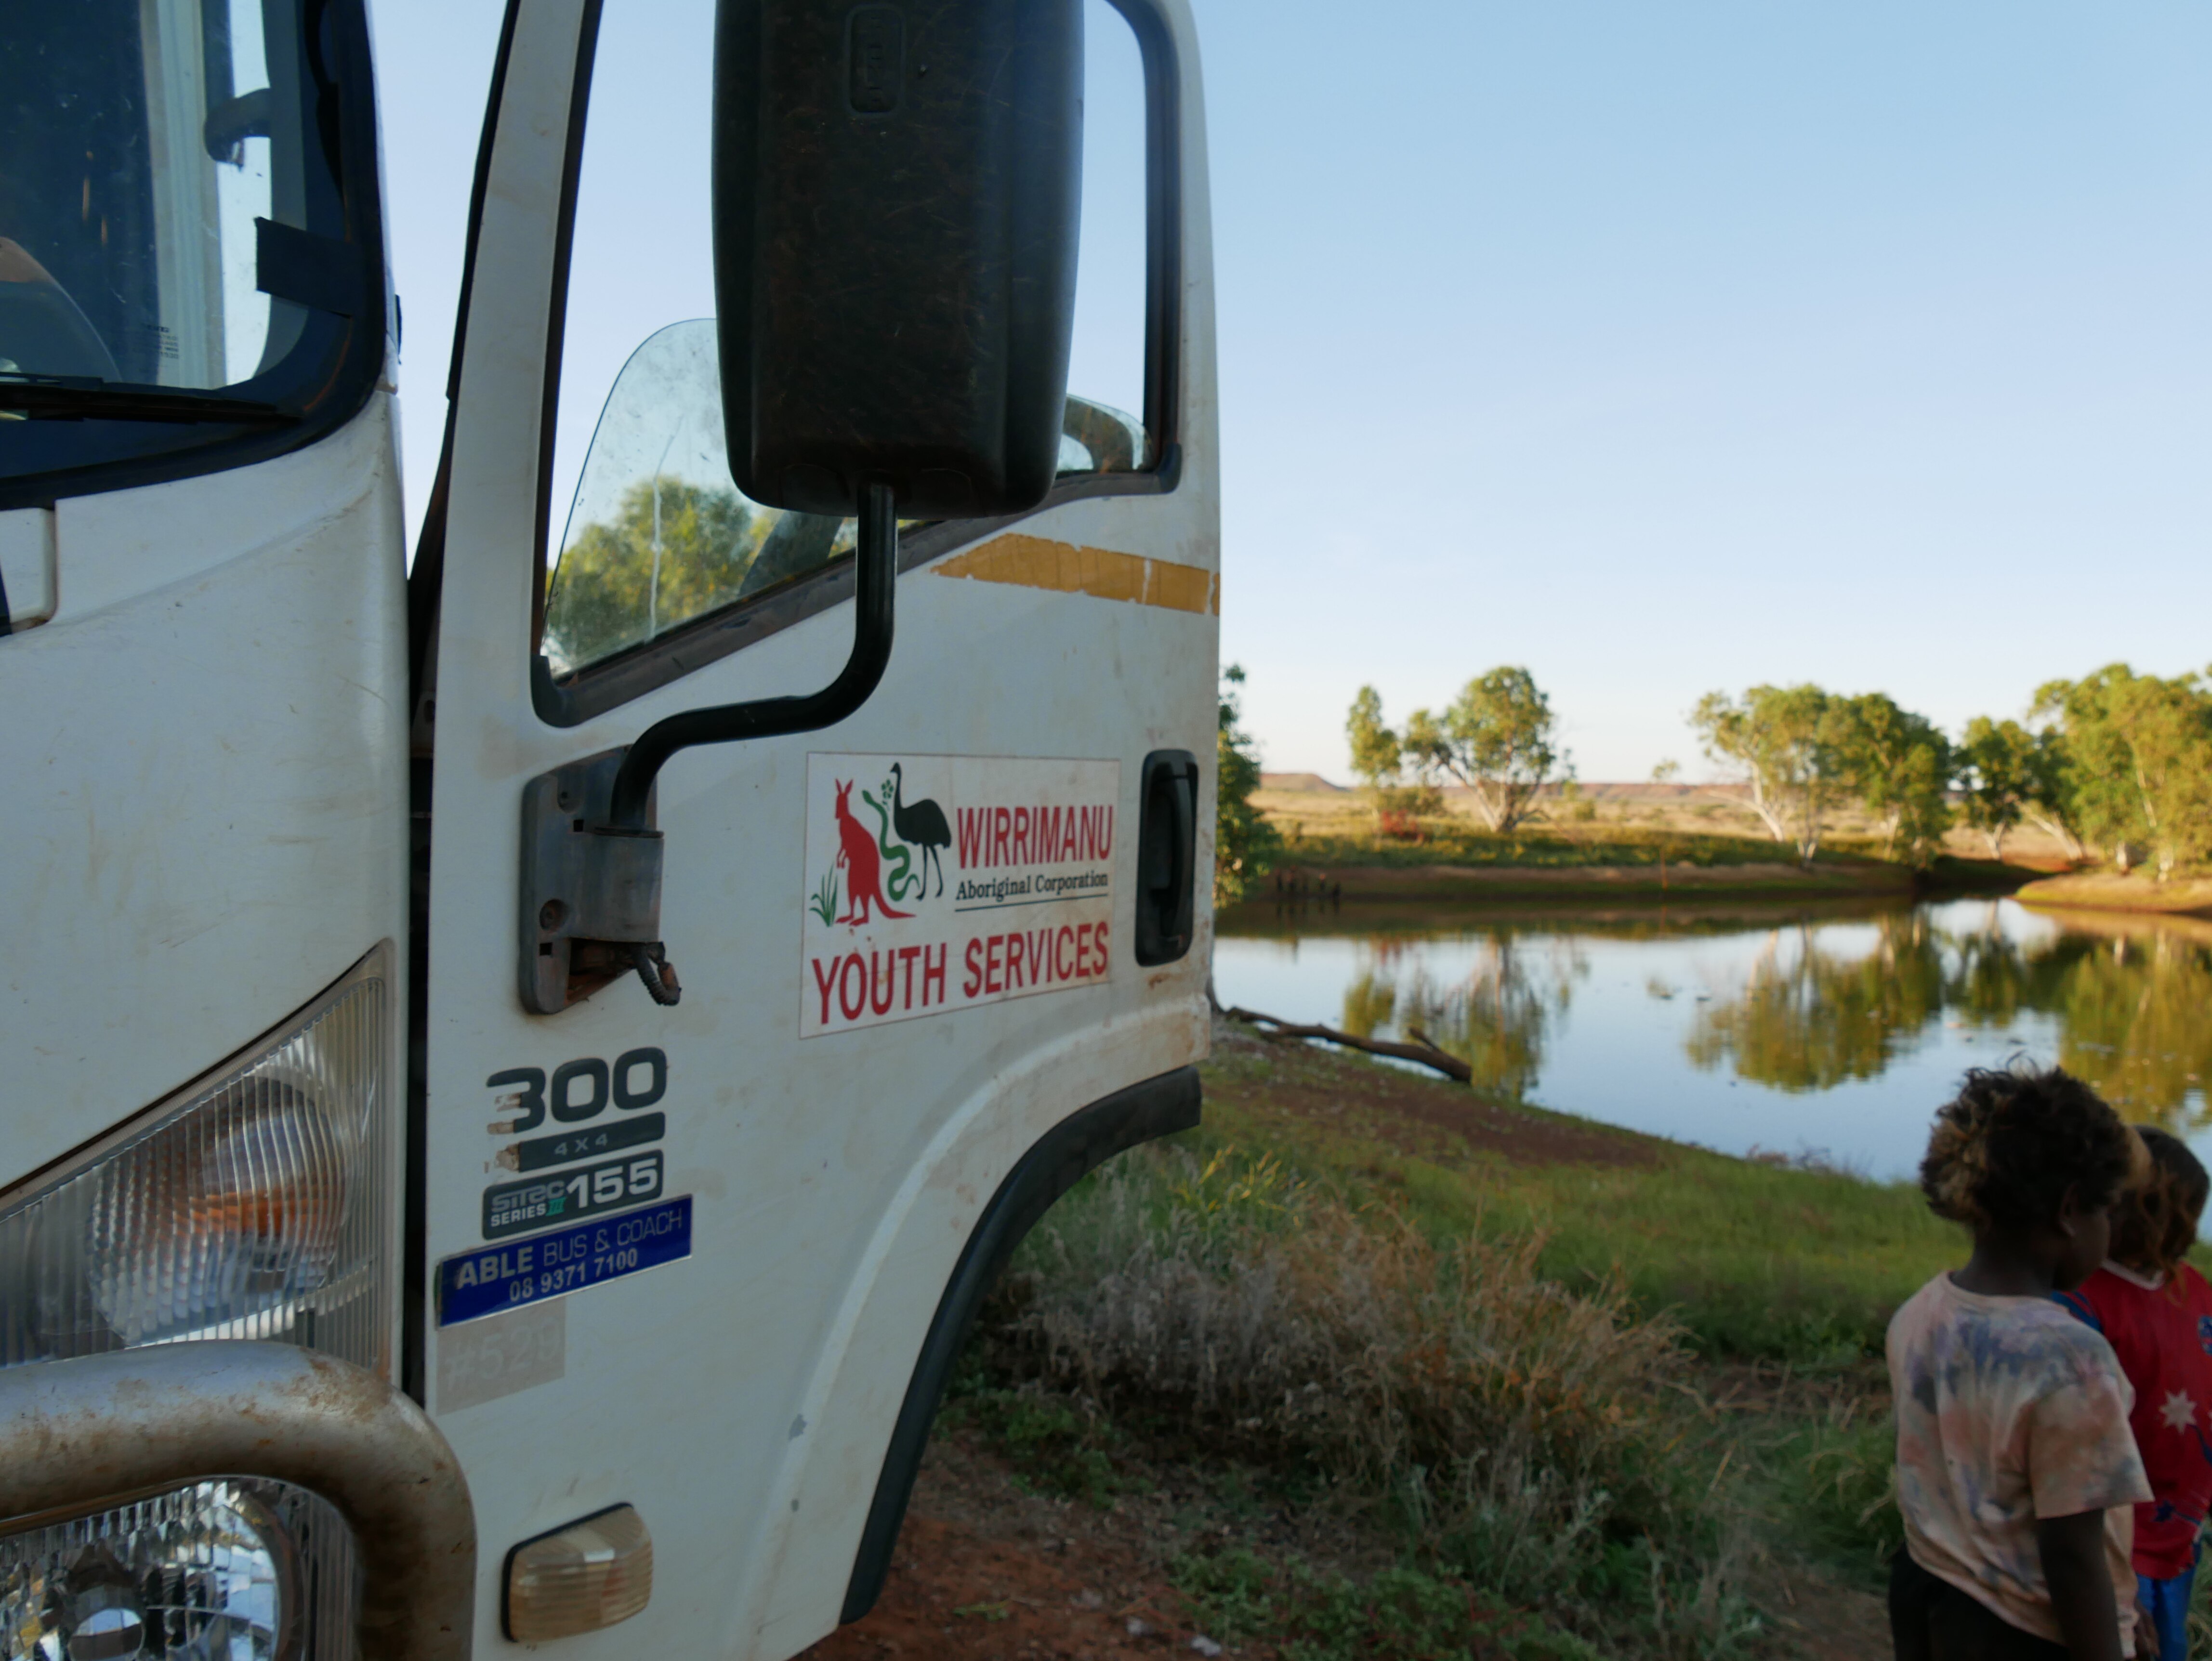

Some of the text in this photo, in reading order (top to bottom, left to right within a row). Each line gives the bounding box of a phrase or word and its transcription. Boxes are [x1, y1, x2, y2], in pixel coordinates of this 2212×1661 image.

[957, 805, 1113, 869] WIRRIMANU
[956, 870, 1107, 902] Aboriginal Corporation
[812, 921, 1108, 1025] YOUTH SERVICES
[486, 1046, 667, 1134] 300
[566, 1158, 658, 1209] 155
[490, 1203, 546, 1227] SERIES
[456, 1208, 682, 1290] ABLE BUS & COACH
[509, 1248, 638, 1303] 08 9371 7100
